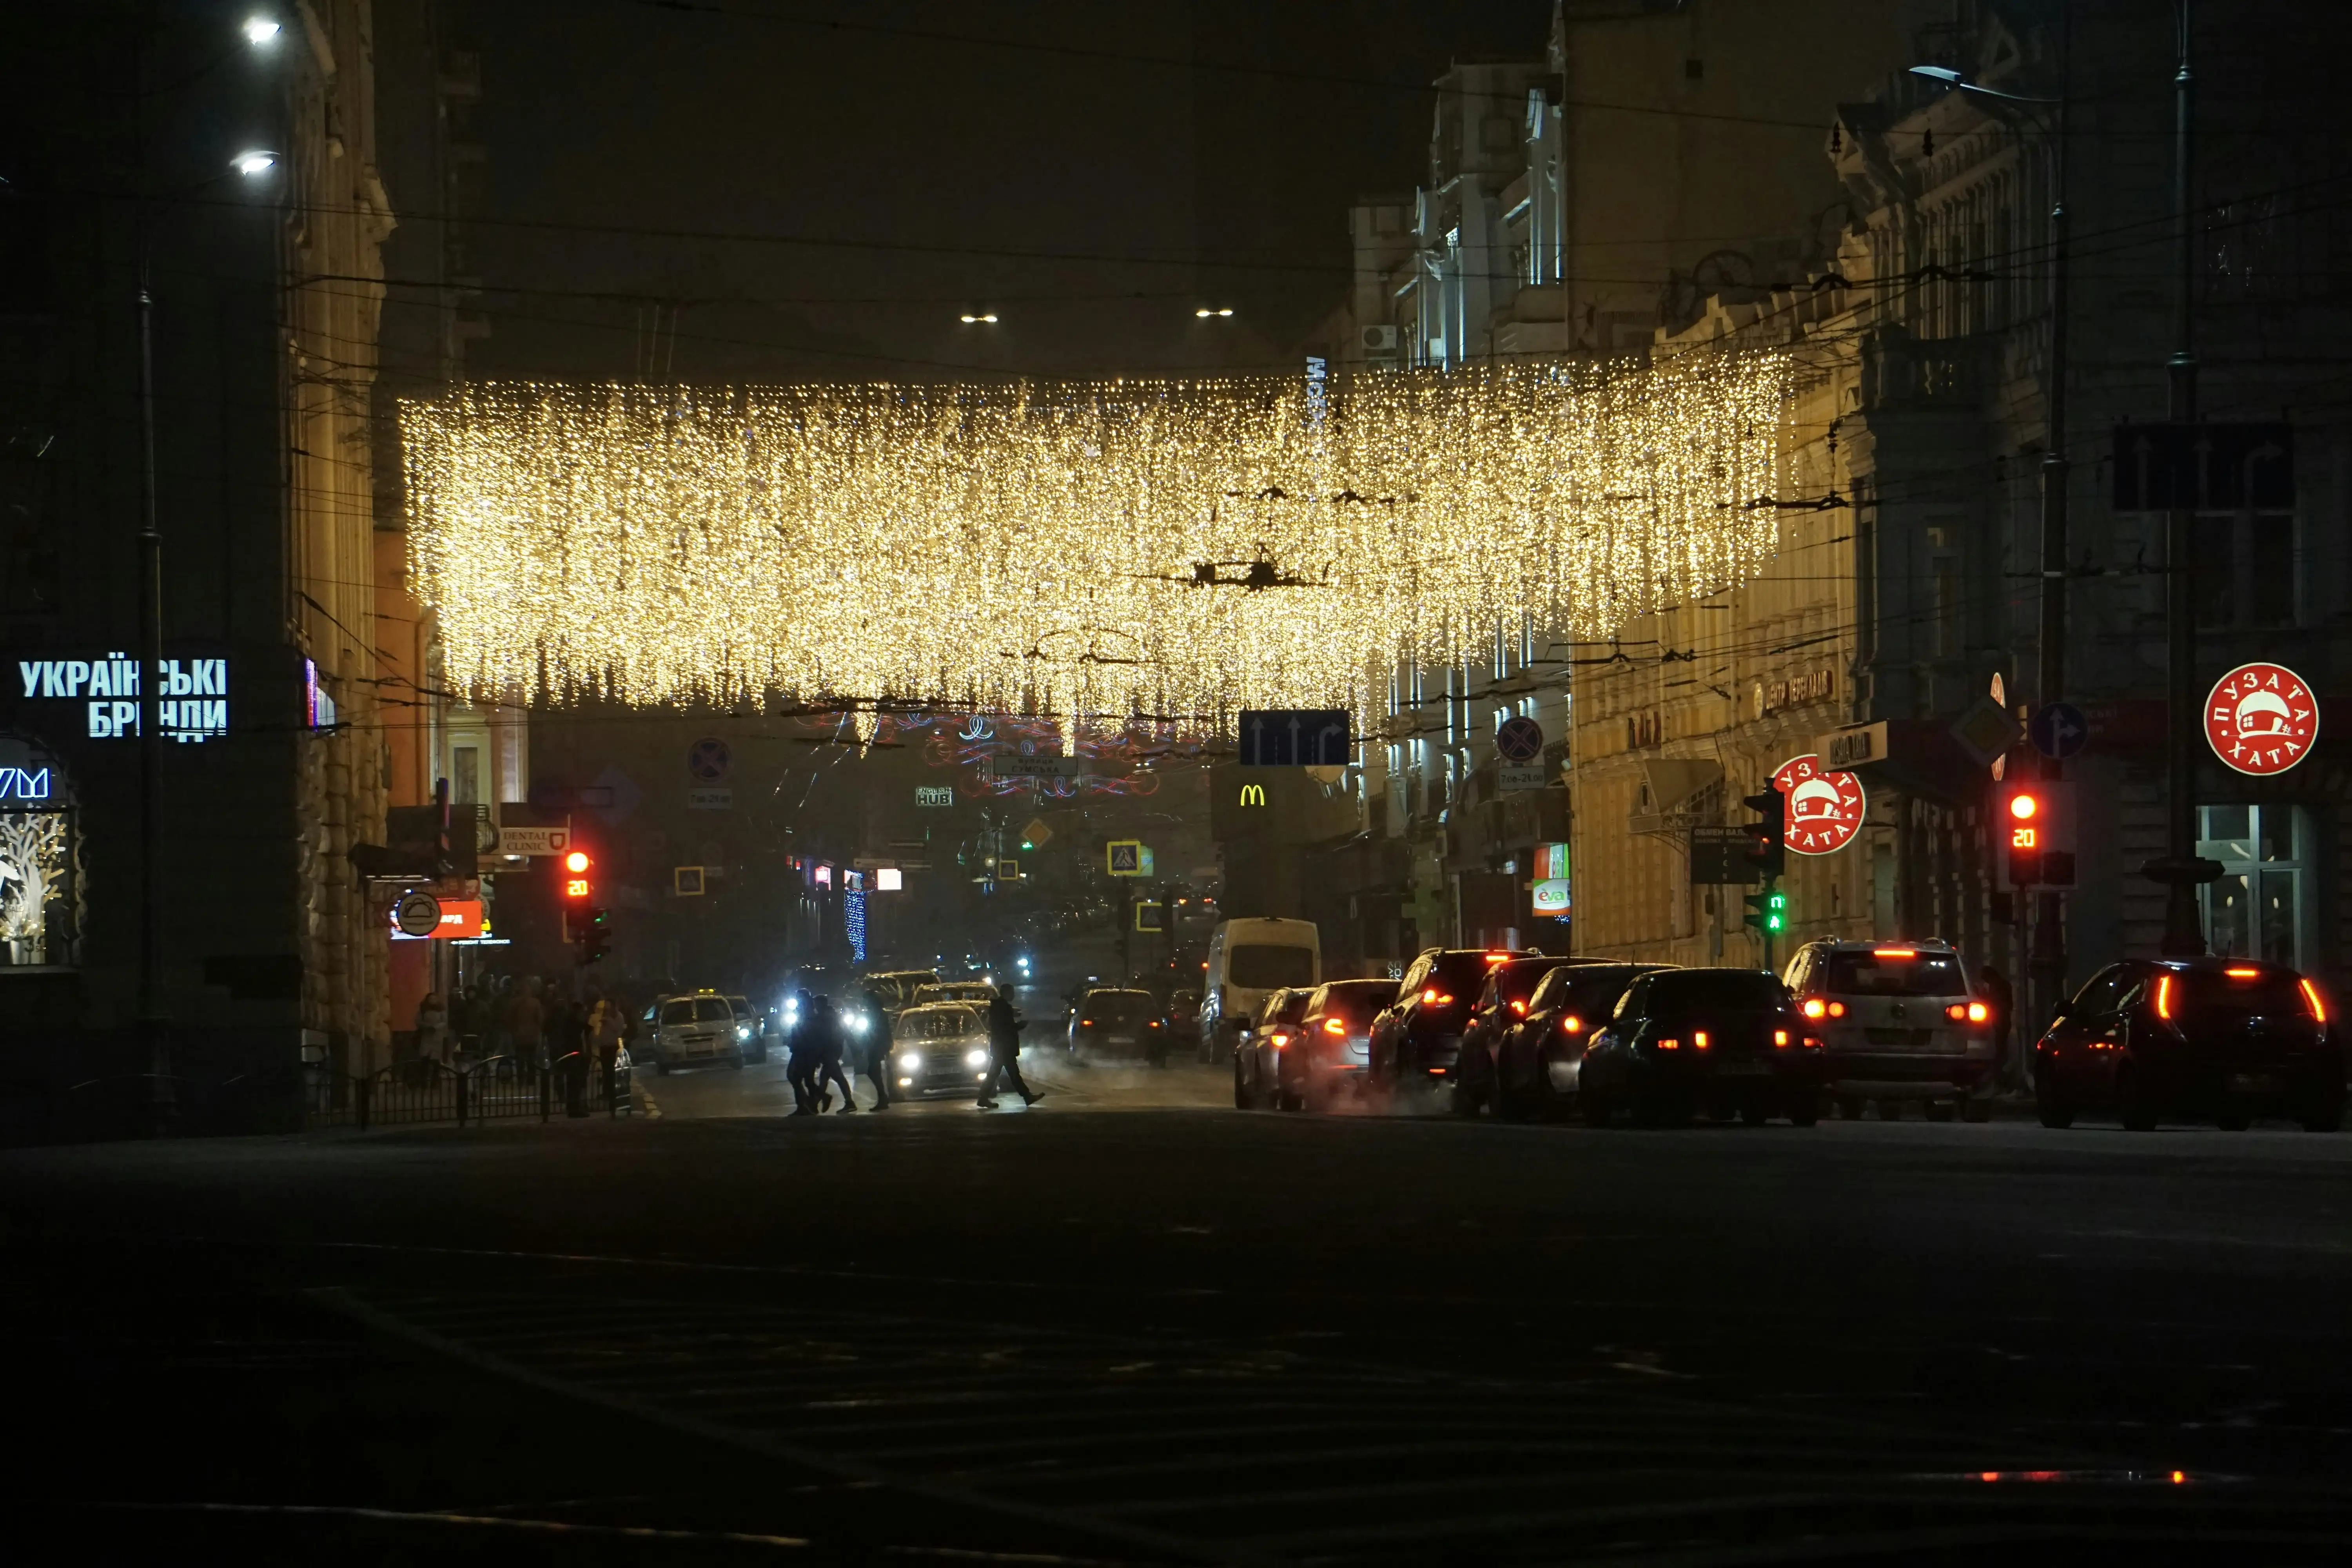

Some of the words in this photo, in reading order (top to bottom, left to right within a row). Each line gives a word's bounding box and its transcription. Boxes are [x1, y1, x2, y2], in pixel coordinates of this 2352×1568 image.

[2214, 673, 2310, 722] ПУЗАТА
[88, 700, 227, 743] БРНДИ
[2227, 740, 2301, 766] ХАТА
[1780, 763, 1857, 808] УЗТА
[918, 794, 949, 804] HUB
[1784, 824, 1850, 847] ХАТА
[2013, 829, 2034, 847] 20
[568, 880, 588, 895] 20
